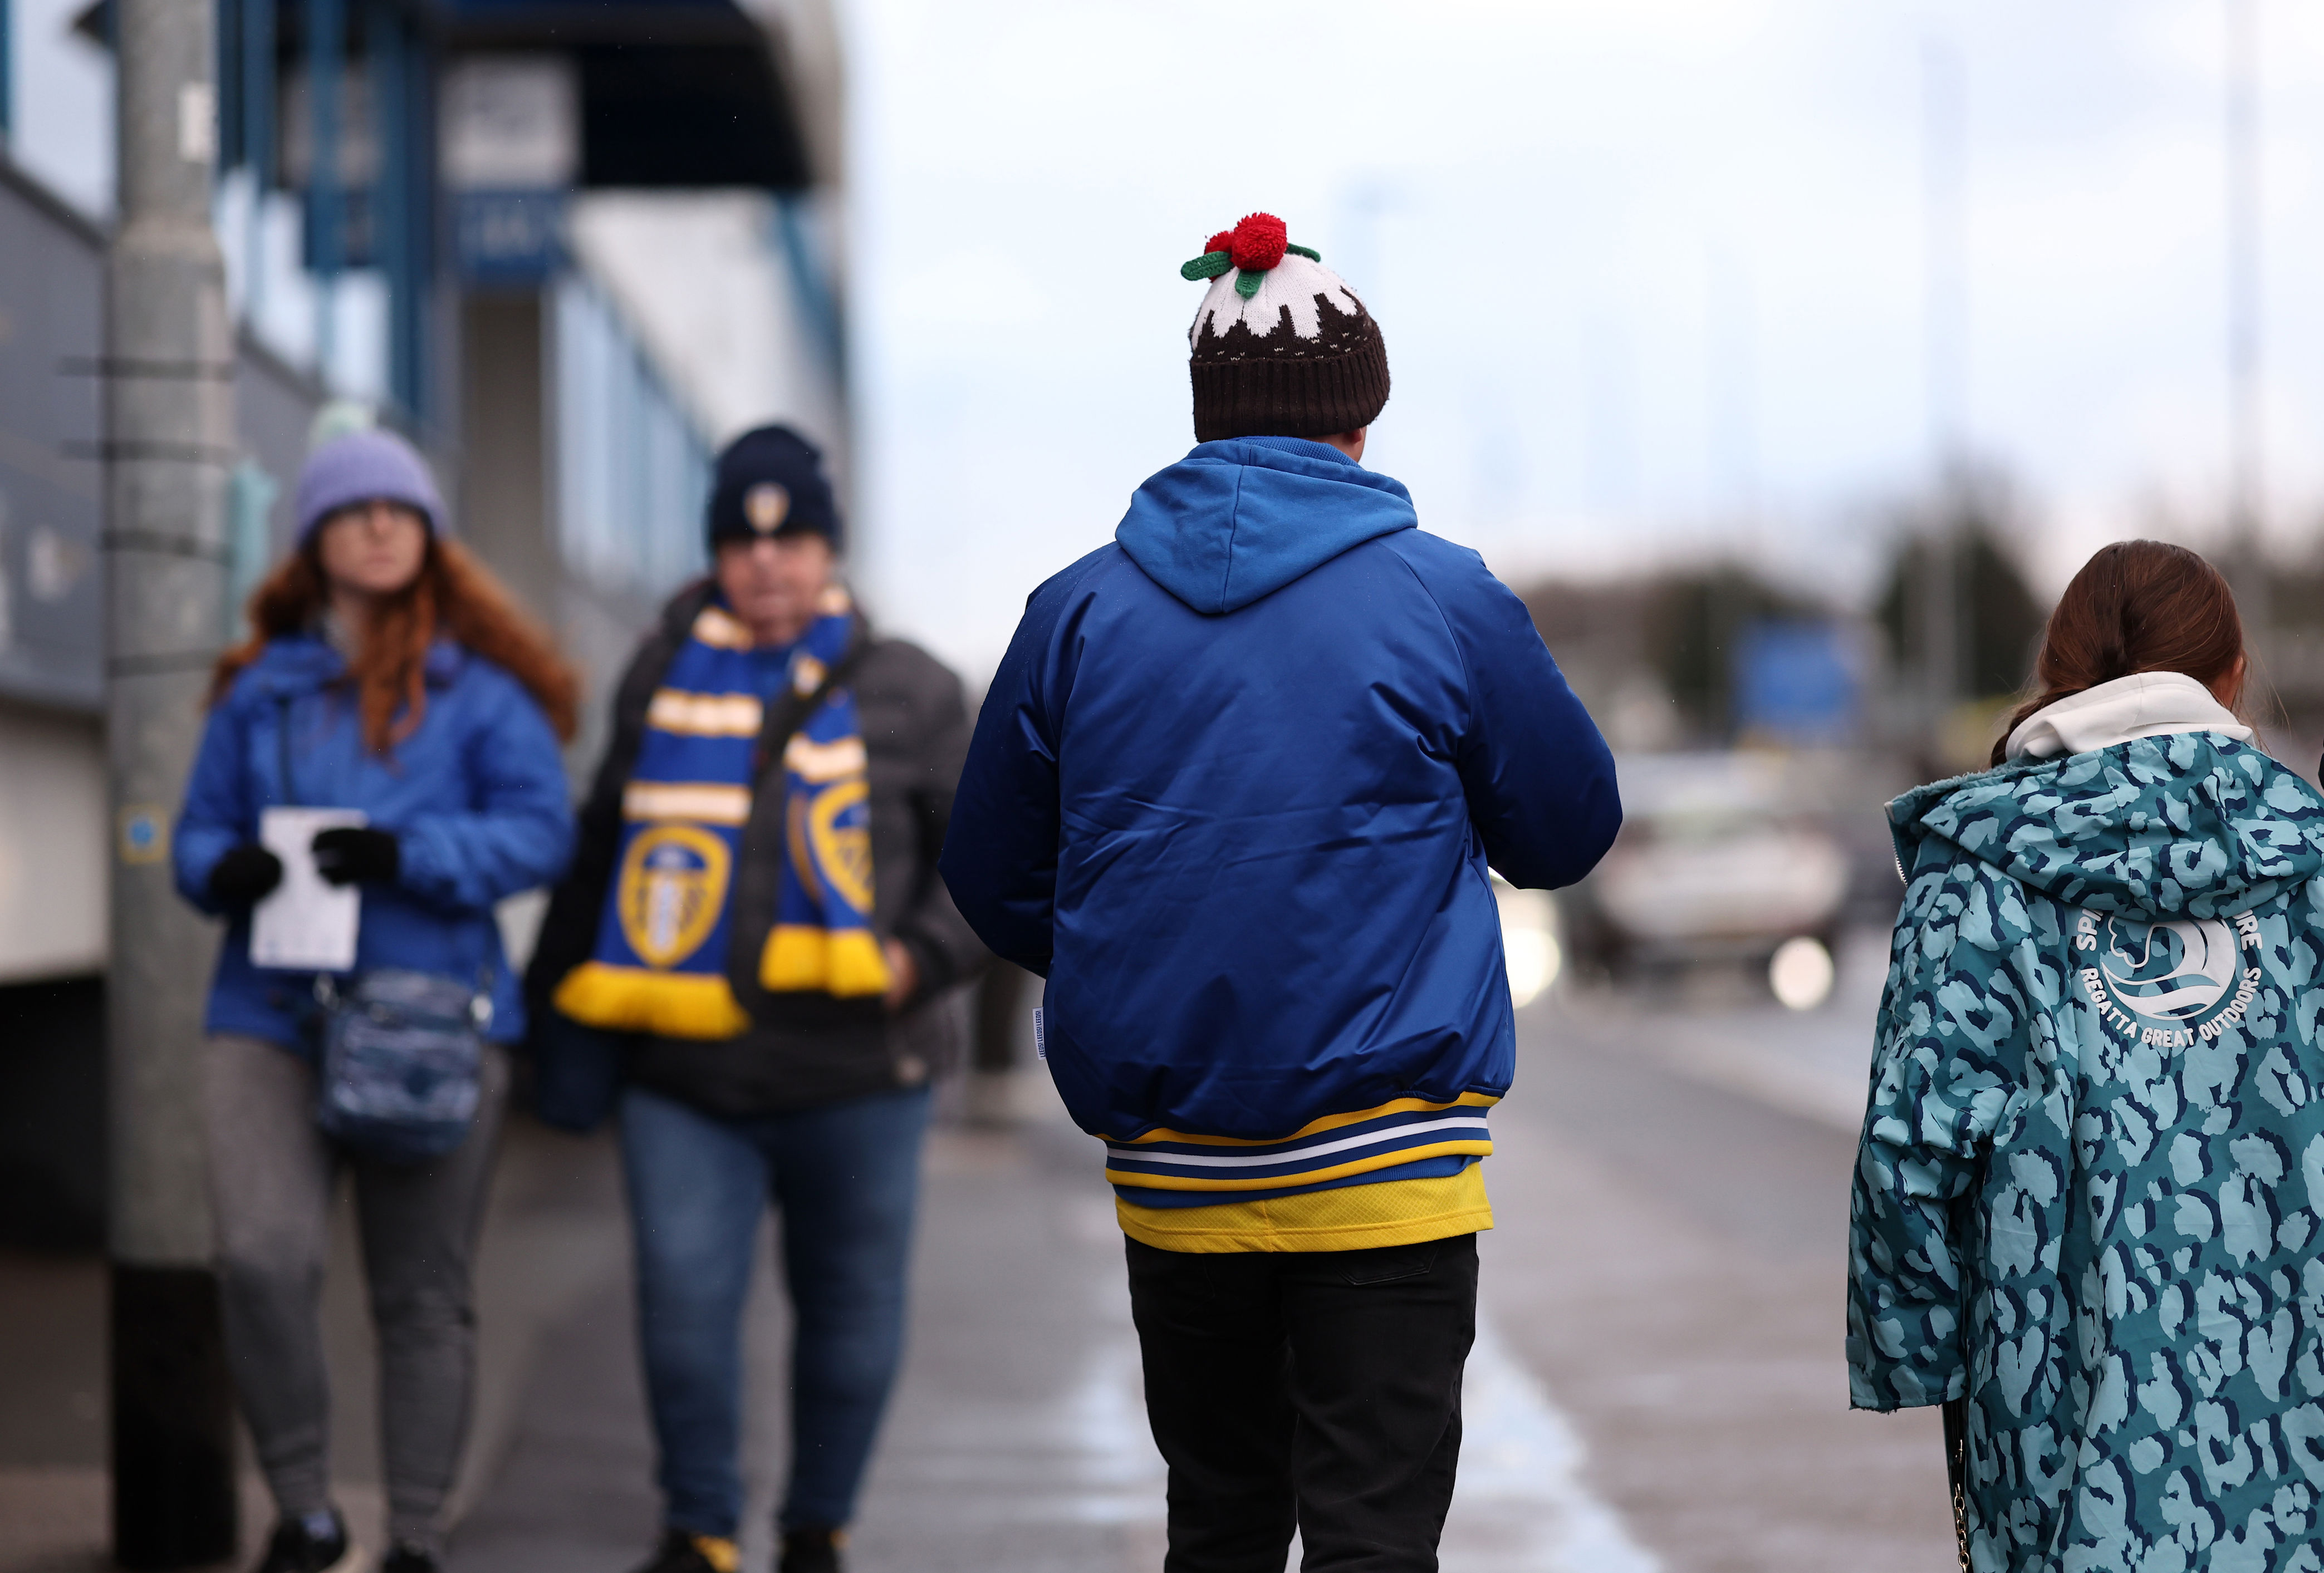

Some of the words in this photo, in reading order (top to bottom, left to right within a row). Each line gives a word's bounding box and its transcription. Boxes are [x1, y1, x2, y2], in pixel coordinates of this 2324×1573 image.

[2076, 908, 2104, 951] SPI
[2080, 967, 2137, 1039] REGATTA
[2141, 1027, 2195, 1048] GREAT
[2198, 967, 2262, 1041] OUTDOORS
